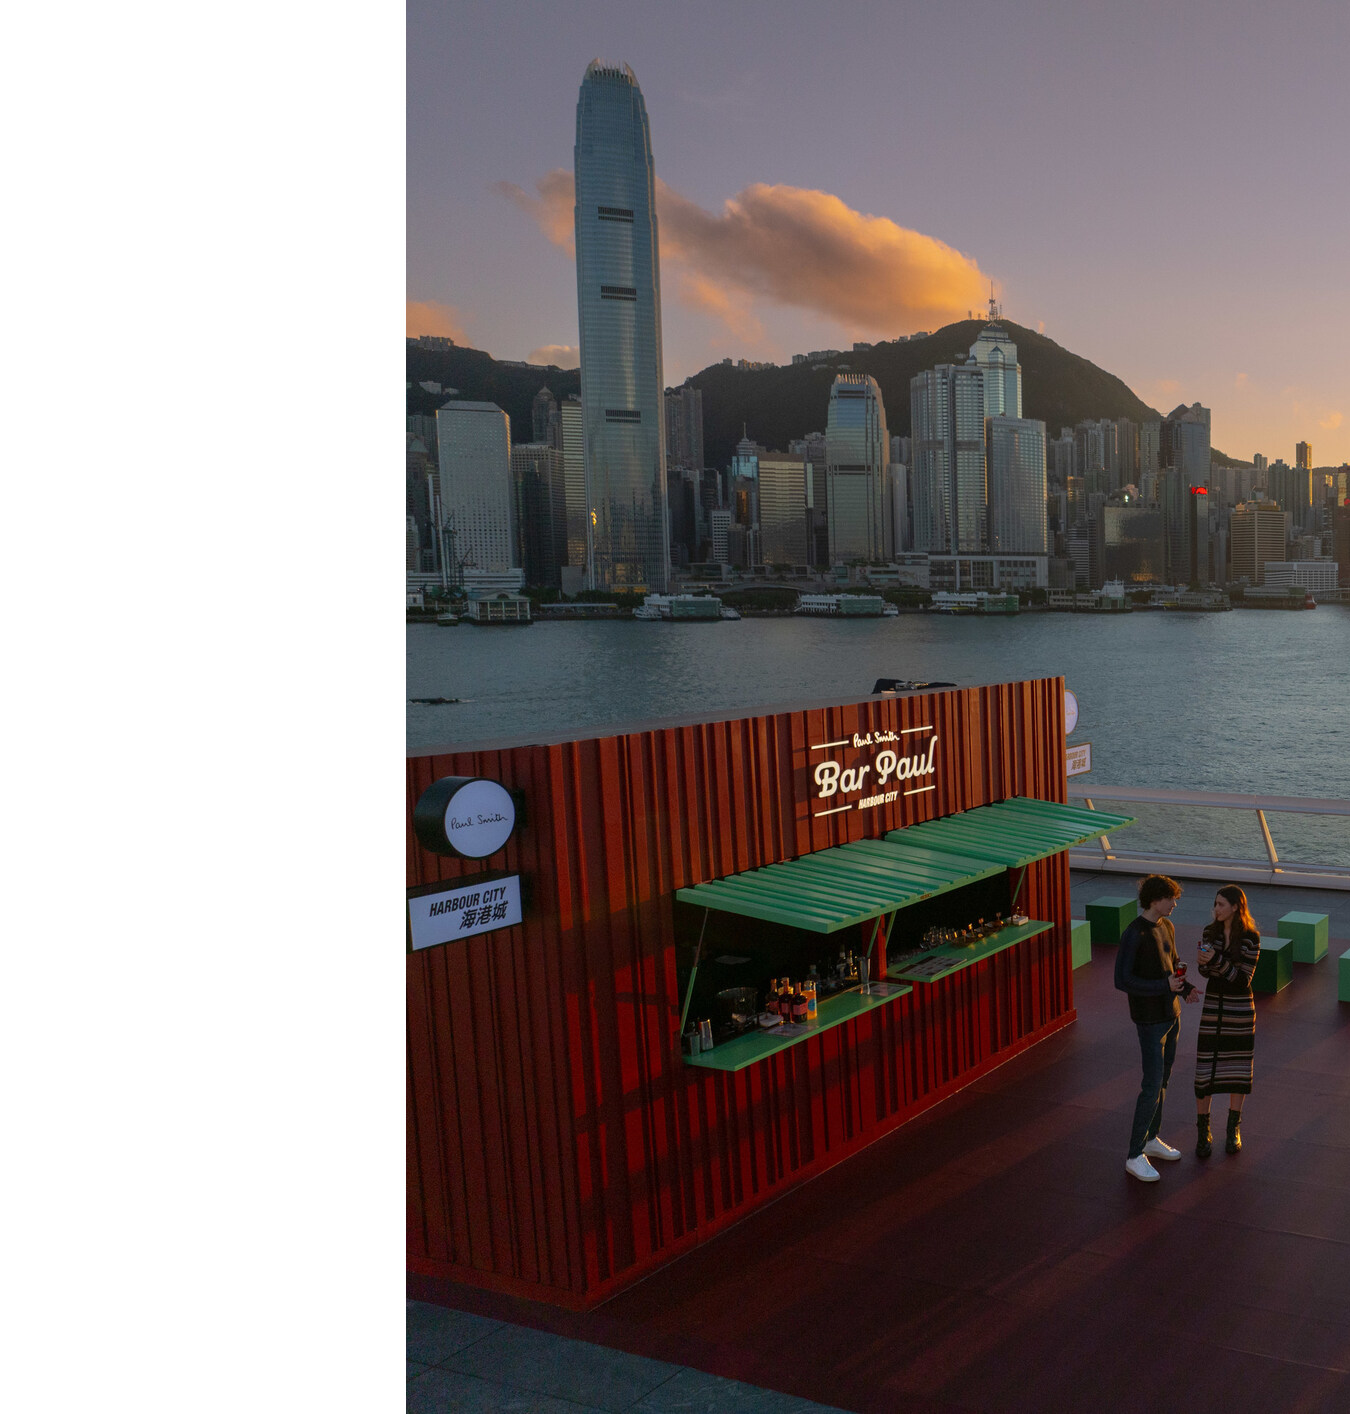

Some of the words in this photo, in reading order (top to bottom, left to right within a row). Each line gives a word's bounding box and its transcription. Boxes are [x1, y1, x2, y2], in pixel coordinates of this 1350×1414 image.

[853, 732, 873, 748] Paul
[874, 730, 900, 744] Smith
[814, 761, 870, 798] Bar
[876, 736, 938, 785] Paul
[858, 793, 884, 810] HARBOUR
[885, 790, 898, 802] CITY
[451, 818, 473, 830] Paul
[478, 813, 507, 825] Smith
[430, 893, 480, 917] HARBOUR
[483, 887, 507, 904] CITY
[459, 901, 508, 930] 海港城
